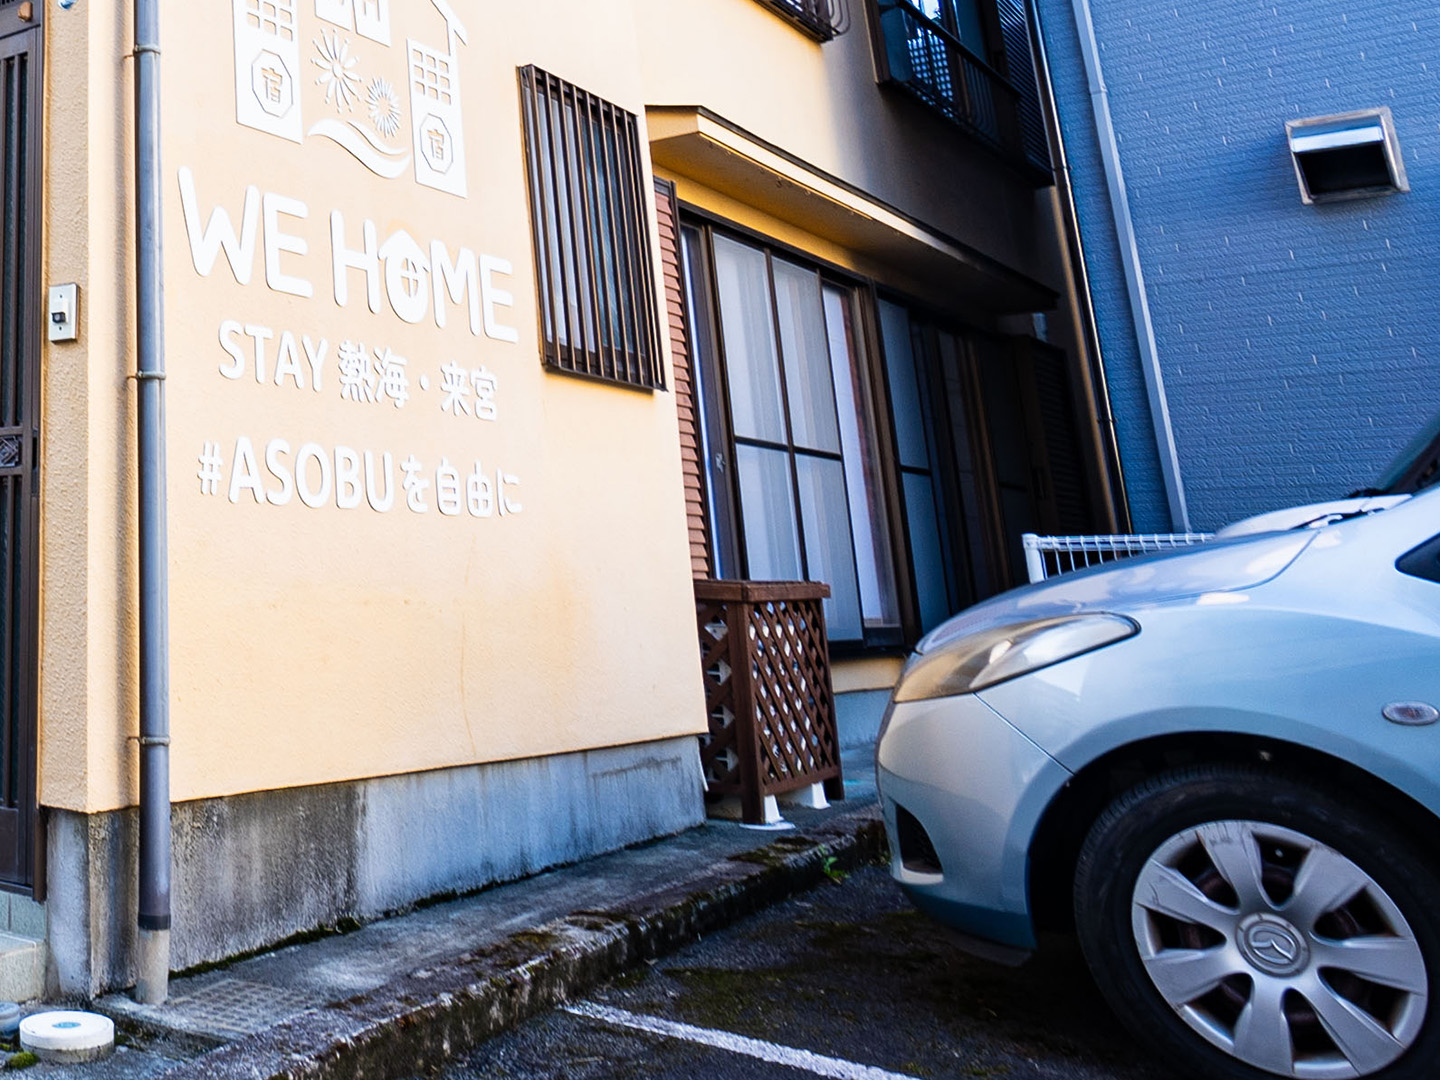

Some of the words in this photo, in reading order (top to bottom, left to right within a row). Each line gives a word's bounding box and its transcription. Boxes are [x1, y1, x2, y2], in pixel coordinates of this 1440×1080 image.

[261, 67, 283, 104] 宿
[427, 128, 445, 161] 宿
[177, 165, 313, 299] WE
[330, 209, 519, 344] HOME
[218, 320, 329, 392] STAY
